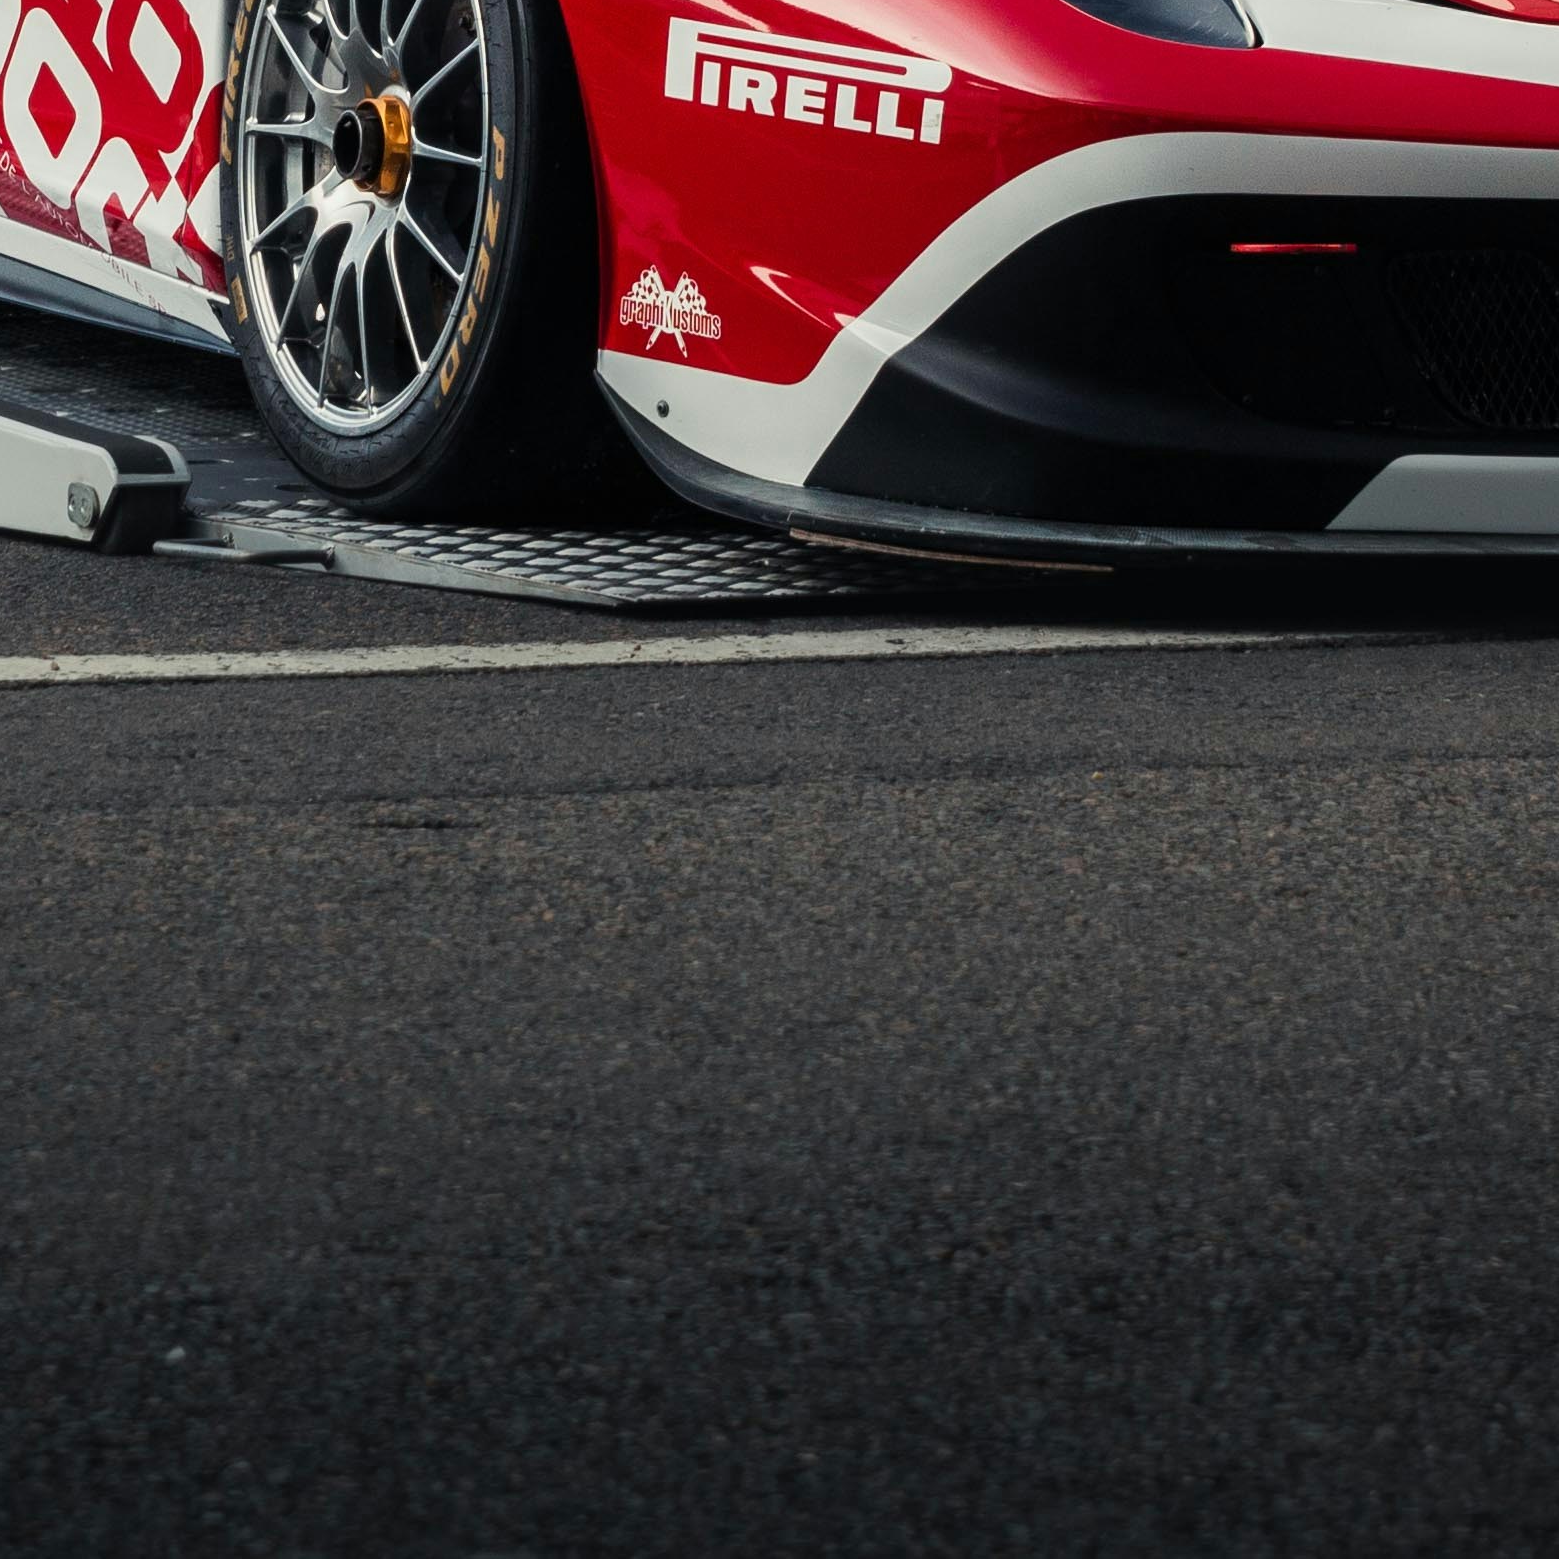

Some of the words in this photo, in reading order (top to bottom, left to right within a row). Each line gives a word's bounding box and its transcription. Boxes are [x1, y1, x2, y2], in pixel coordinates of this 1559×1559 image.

[663, 16, 953, 146] PIRELLI
[492, 125, 506, 181] P
[438, 187, 502, 398] ZERO
